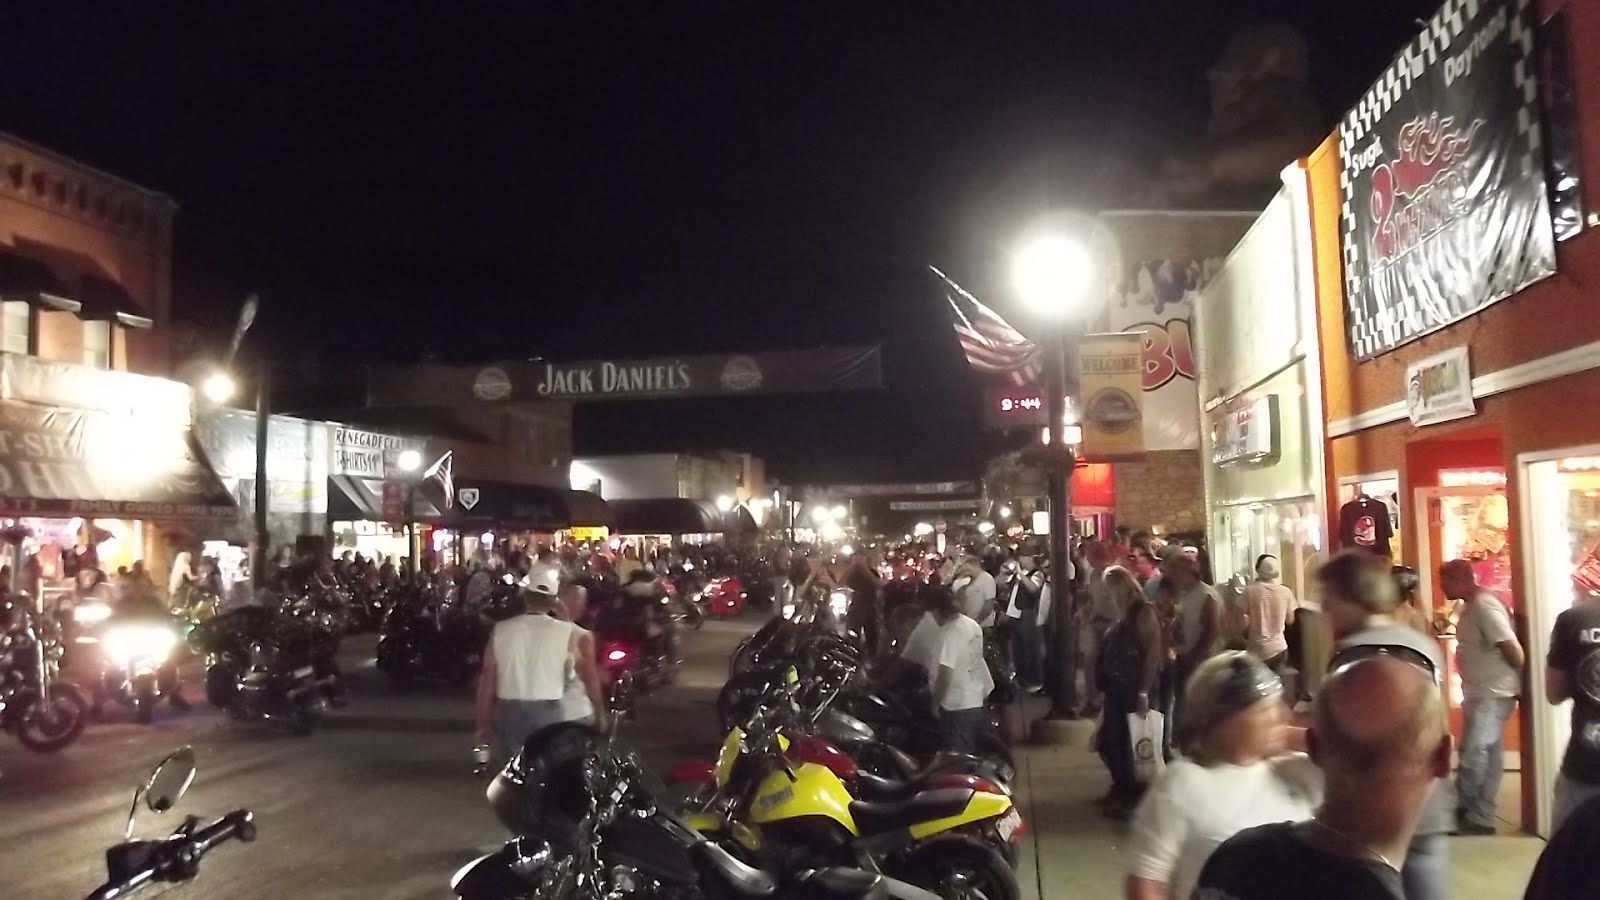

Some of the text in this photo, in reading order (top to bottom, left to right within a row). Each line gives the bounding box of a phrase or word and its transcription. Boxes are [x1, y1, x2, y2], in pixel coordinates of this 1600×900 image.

[1082, 355, 1138, 373] WELCOME
[538, 364, 594, 395] JACK
[601, 361, 691, 392] DANIEL'S
[1001, 397, 1041, 411] 9:44
[336, 429, 383, 449] RENEGADE
[71, 501, 120, 513] FAMILY
[125, 502, 174, 515] OWNED
